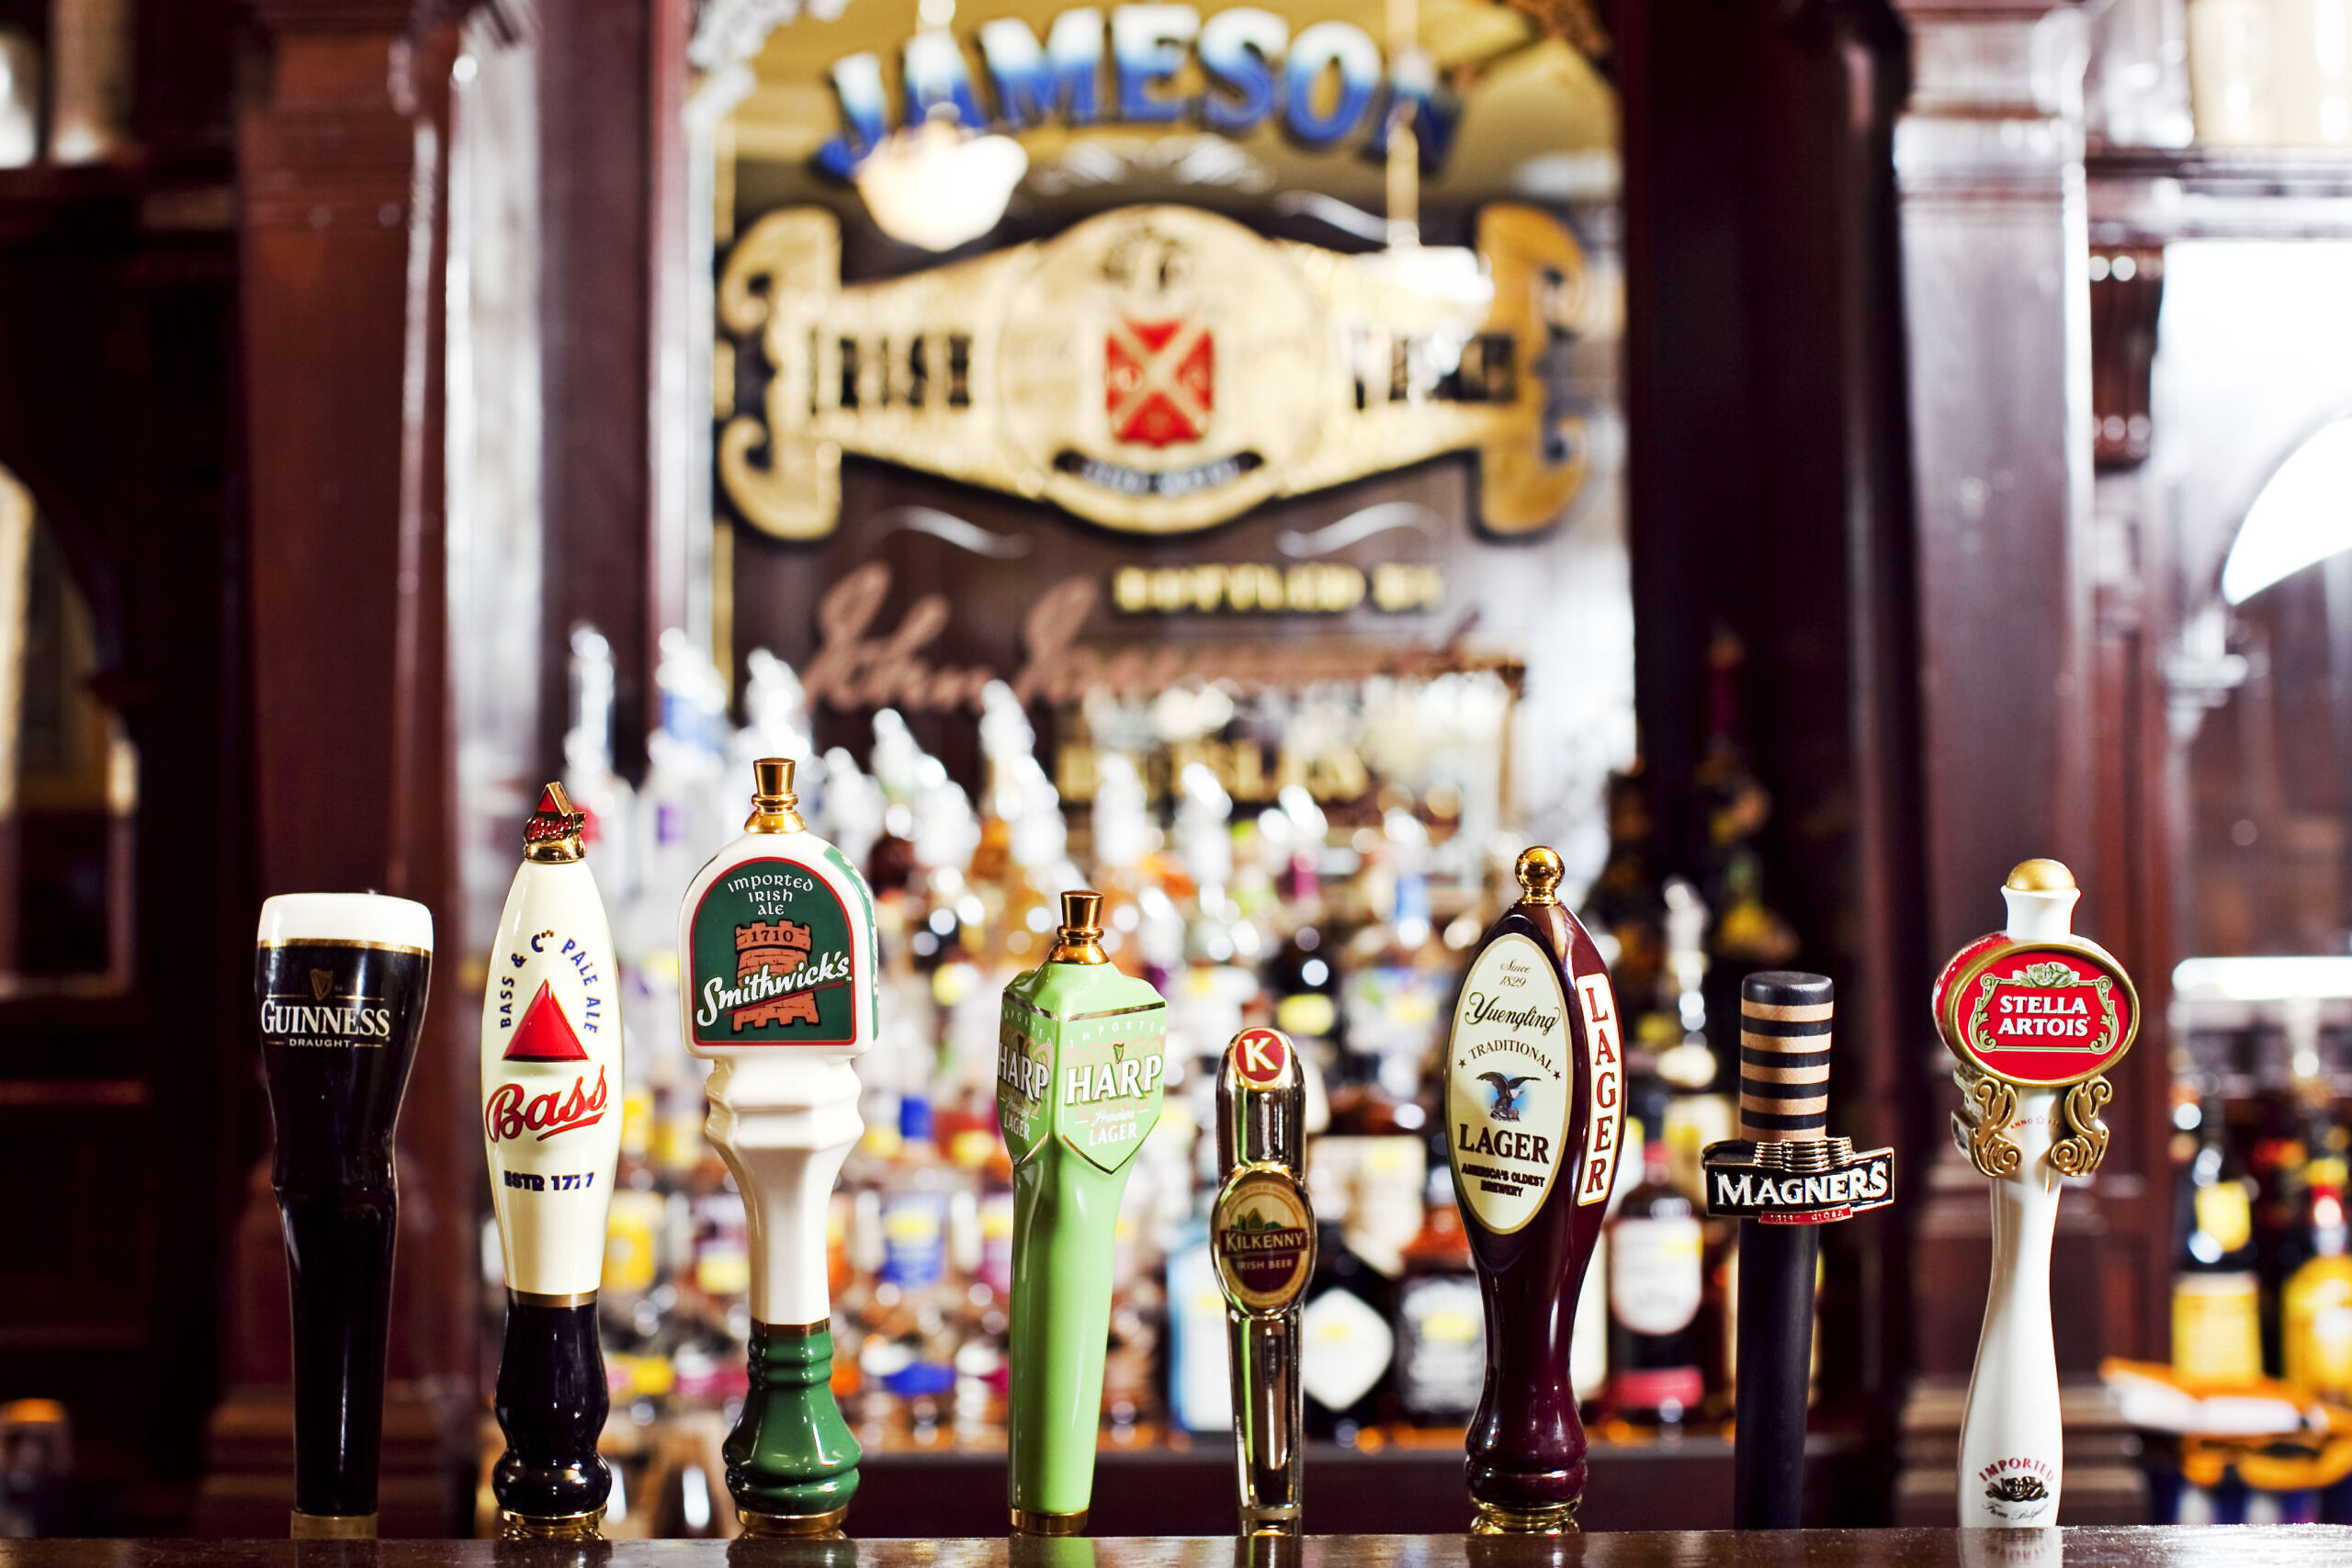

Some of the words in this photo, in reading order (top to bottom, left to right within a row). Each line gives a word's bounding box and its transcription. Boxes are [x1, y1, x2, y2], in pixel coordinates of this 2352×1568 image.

[812, 3, 1464, 178] JAMESON
[751, 930, 794, 942] 1710
[1498, 976, 1527, 987] 1829
[1499, 959, 1532, 974] Since
[499, 975, 515, 1029] BASS
[511, 953, 527, 968] &
[560, 937, 598, 987] PALE
[583, 996, 601, 1034] ALE
[696, 950, 850, 1027] Smithwick's
[261, 998, 390, 1037] GUINNESS
[1464, 991, 1561, 1036] Yuengling
[1999, 995, 2089, 1016] STELLA
[288, 1038, 352, 1048] DRAUGHT
[1069, 1020, 1166, 1048] IMPORTED
[1997, 1017, 2089, 1037] ARTOIS
[1242, 1036, 1279, 1073] K
[1468, 1038, 1554, 1073] TRADITIONAL
[998, 1042, 1049, 1104] HARP
[1064, 1055, 1164, 1106] HARP
[485, 1063, 607, 1144] Bass
[1585, 987, 1617, 1194] LAGER
[1003, 1111, 1031, 1142] LAGER
[1088, 1121, 1139, 1146] LAGER
[1458, 1122, 1550, 1165] LAGER
[550, 1171, 595, 1190] 1777
[1714, 1159, 1888, 1207] MAGNERS
[1225, 1232, 1304, 1253] KILKENNY
[1237, 1261, 1265, 1270] IRISH
[1268, 1258, 1293, 1269] BEER
[1978, 1457, 2055, 1483] IMPORTED
